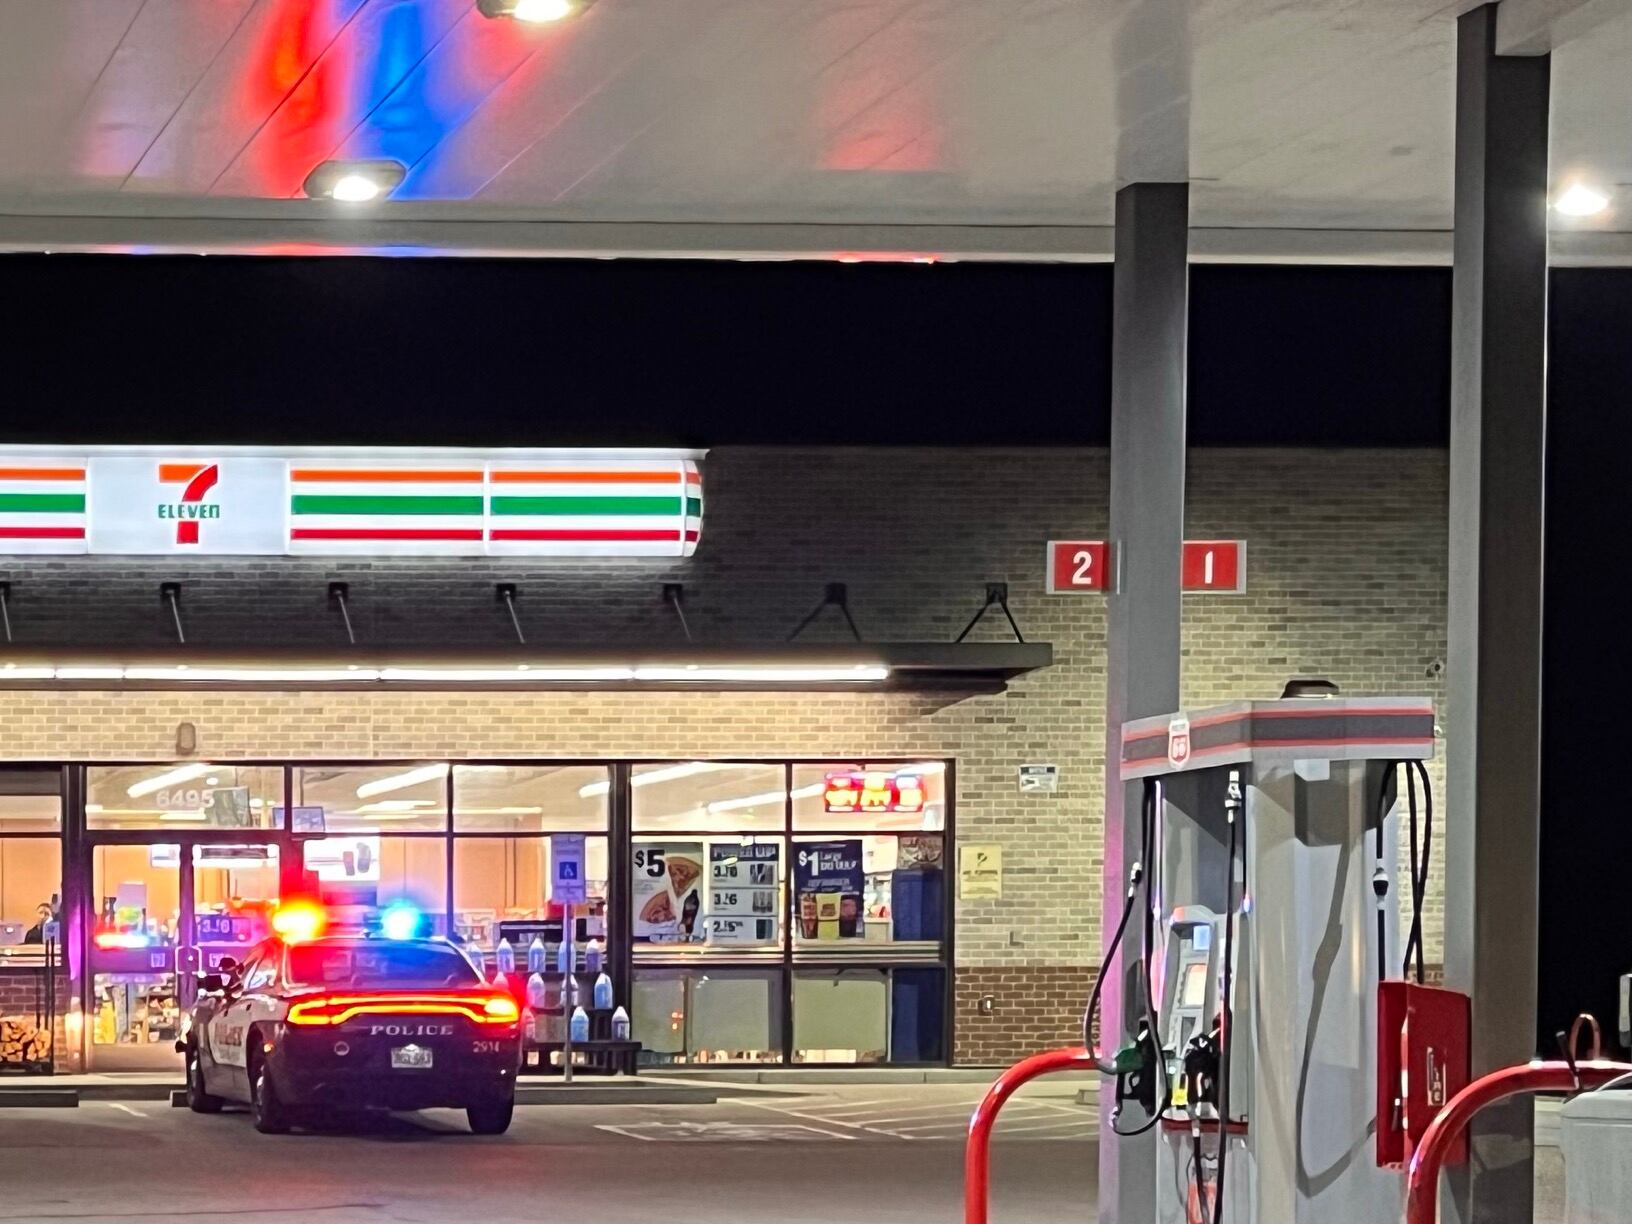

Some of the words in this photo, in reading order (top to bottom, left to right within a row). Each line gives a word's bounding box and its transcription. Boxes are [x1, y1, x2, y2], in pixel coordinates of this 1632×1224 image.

[1072, 551, 1092, 584] 2
[1204, 551, 1214, 584] 1
[156, 788, 215, 808] 6495
[634, 849, 666, 877] $5
[798, 850, 819, 877] $1
[370, 1024, 454, 1036] POLICE
